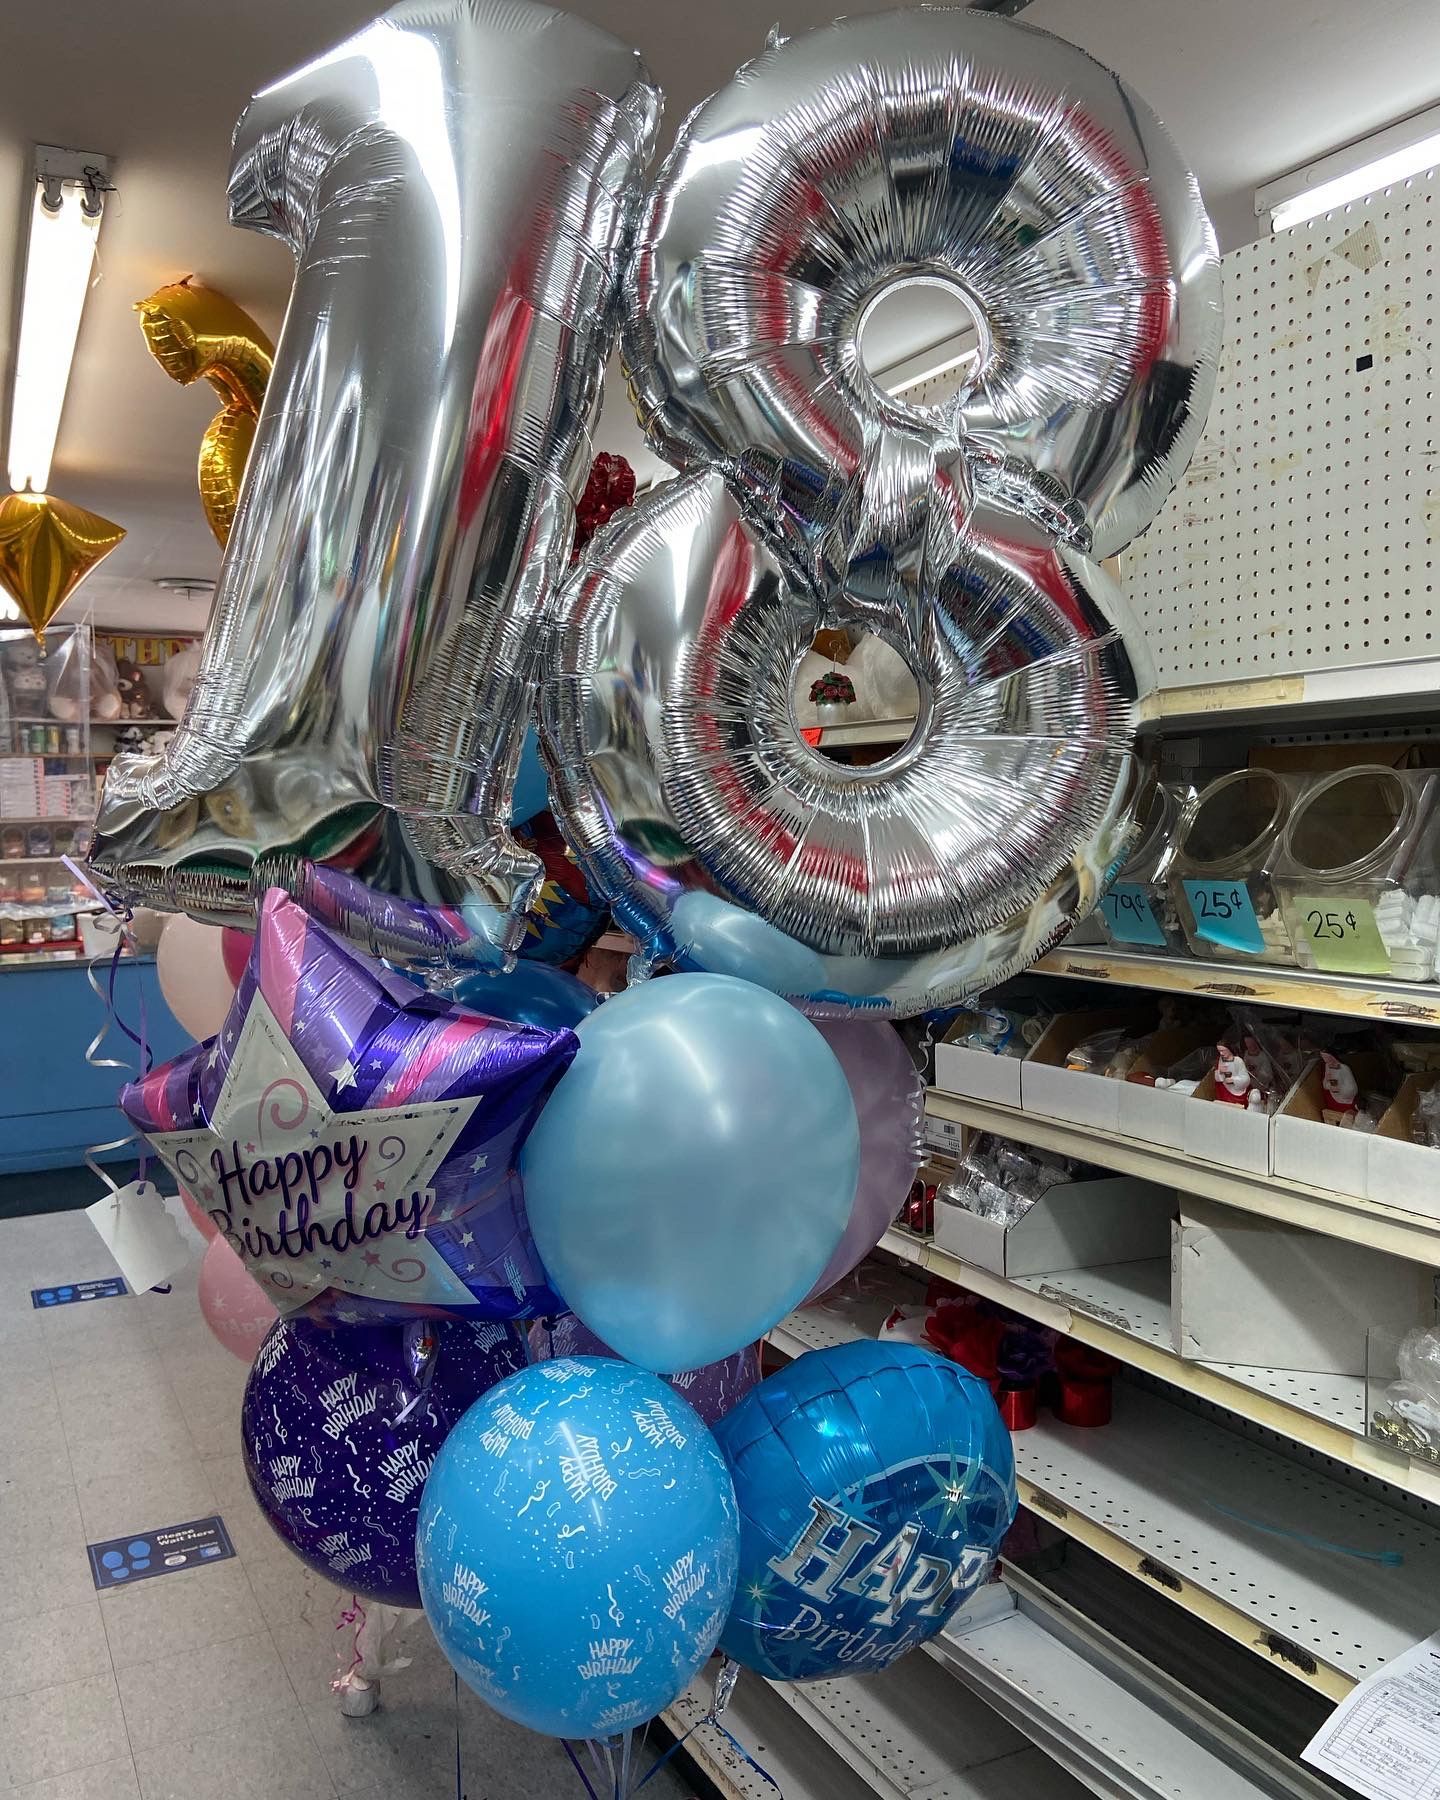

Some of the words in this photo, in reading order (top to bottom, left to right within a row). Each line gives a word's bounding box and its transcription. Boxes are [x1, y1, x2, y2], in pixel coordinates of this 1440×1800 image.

[1107, 893, 1145, 922] 79¢
[1195, 889, 1240, 919] 25¢
[1307, 910, 1357, 939] 25¢
[210, 1135, 368, 1213] Happy
[208, 1191, 430, 1258] Birthday
[318, 1373, 358, 1413] HAPPY
[322, 1387, 377, 1440] BIRTHDAY
[491, 1403, 536, 1440] BIRTHDAY
[631, 1410, 666, 1449] HAPPY
[643, 1398, 687, 1450] BIRTHDAY
[378, 1439, 420, 1479] HAPPY
[479, 1426, 512, 1459] HAPPY
[269, 1456, 301, 1480] HAPPY
[559, 1455, 591, 1503] HAPPY
[576, 1434, 618, 1501] BIRTHDAY
[271, 1477, 316, 1503] BIRTHDAY
[156, 1528, 195, 1541] Please
[158, 1536, 184, 1546] Wait
[187, 1529, 215, 1540] Here
[317, 1532, 349, 1556] HAPPY
[454, 1563, 489, 1599] HAPPY
[662, 1549, 694, 1593] HAPPY
[442, 1582, 491, 1626] BIRTHDAY
[663, 1562, 707, 1620] BIRTHDAY
[589, 1638, 634, 1660] HAPPY
[578, 1657, 642, 1680] BIRTHDAY
